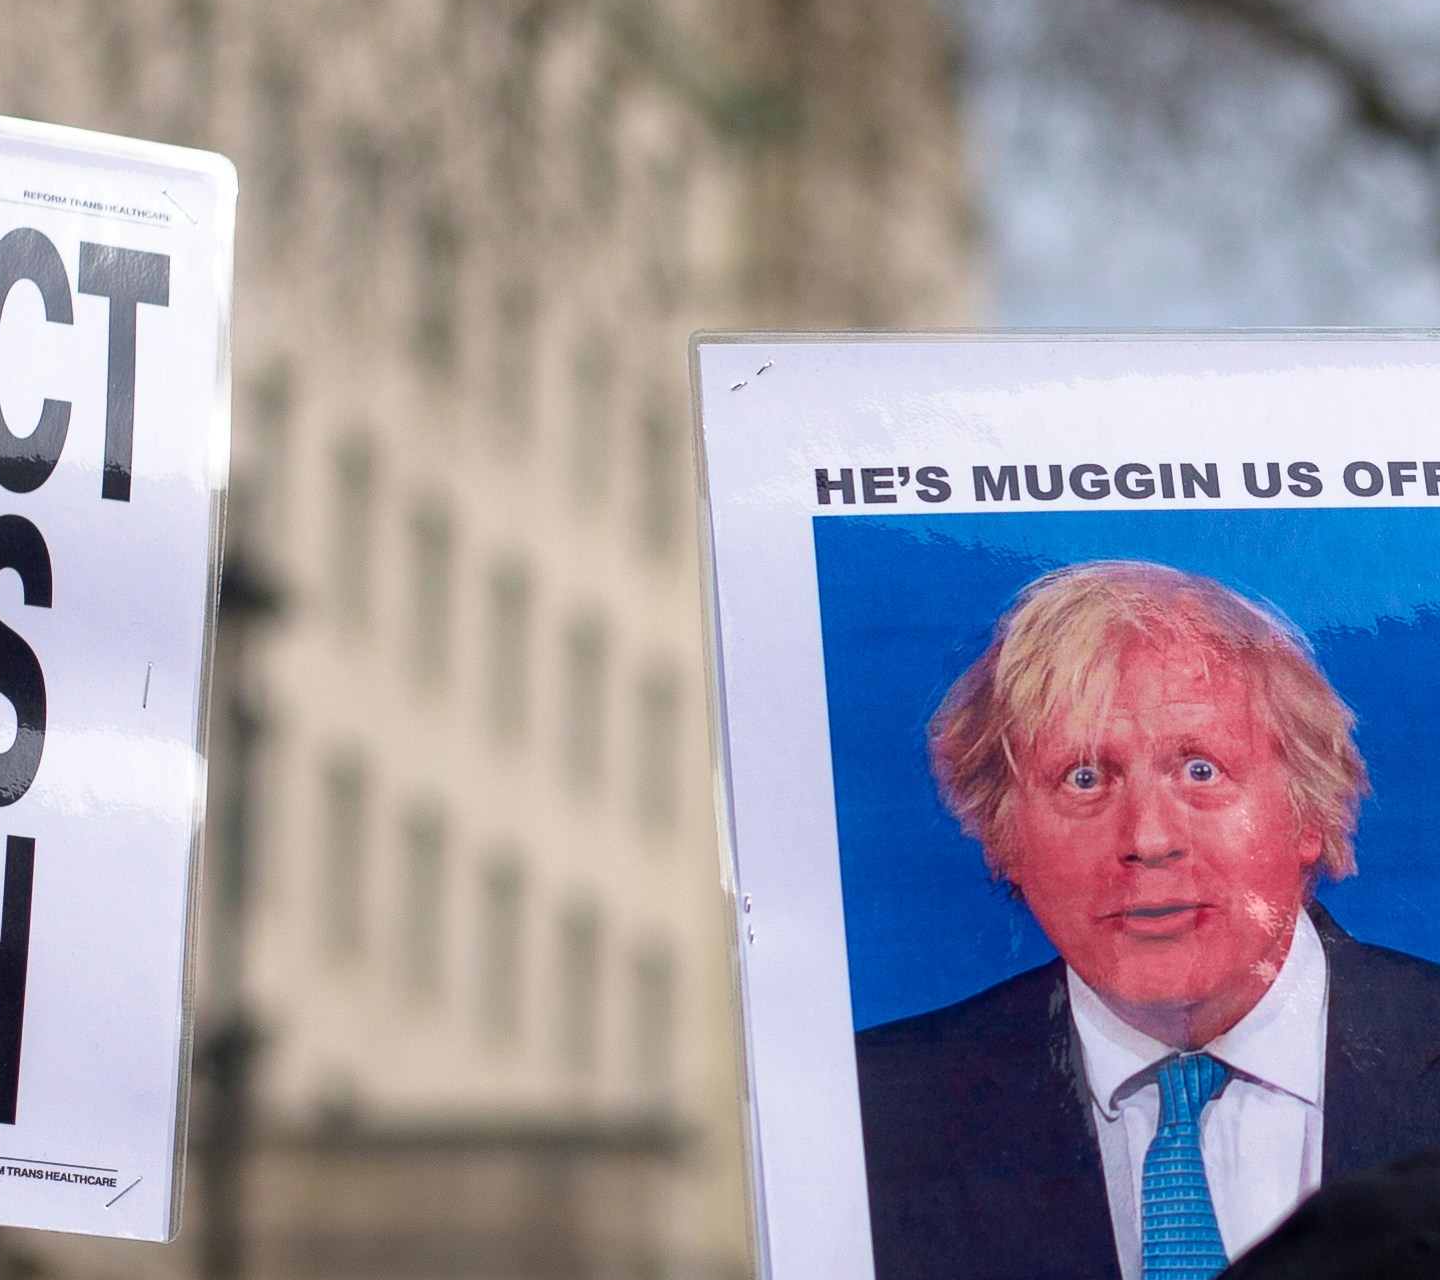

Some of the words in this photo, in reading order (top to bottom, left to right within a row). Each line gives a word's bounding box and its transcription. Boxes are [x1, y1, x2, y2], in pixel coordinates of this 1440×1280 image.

[23, 189, 67, 204] REFORM
[69, 197, 103, 211] TRANS
[813, 465, 953, 506] HE'S
[972, 462, 1221, 503] MUGGIN
[1244, 460, 1324, 499] US
[7, 1166, 43, 1180] TRANS
[45, 1170, 117, 1187] HEALTHCARE
